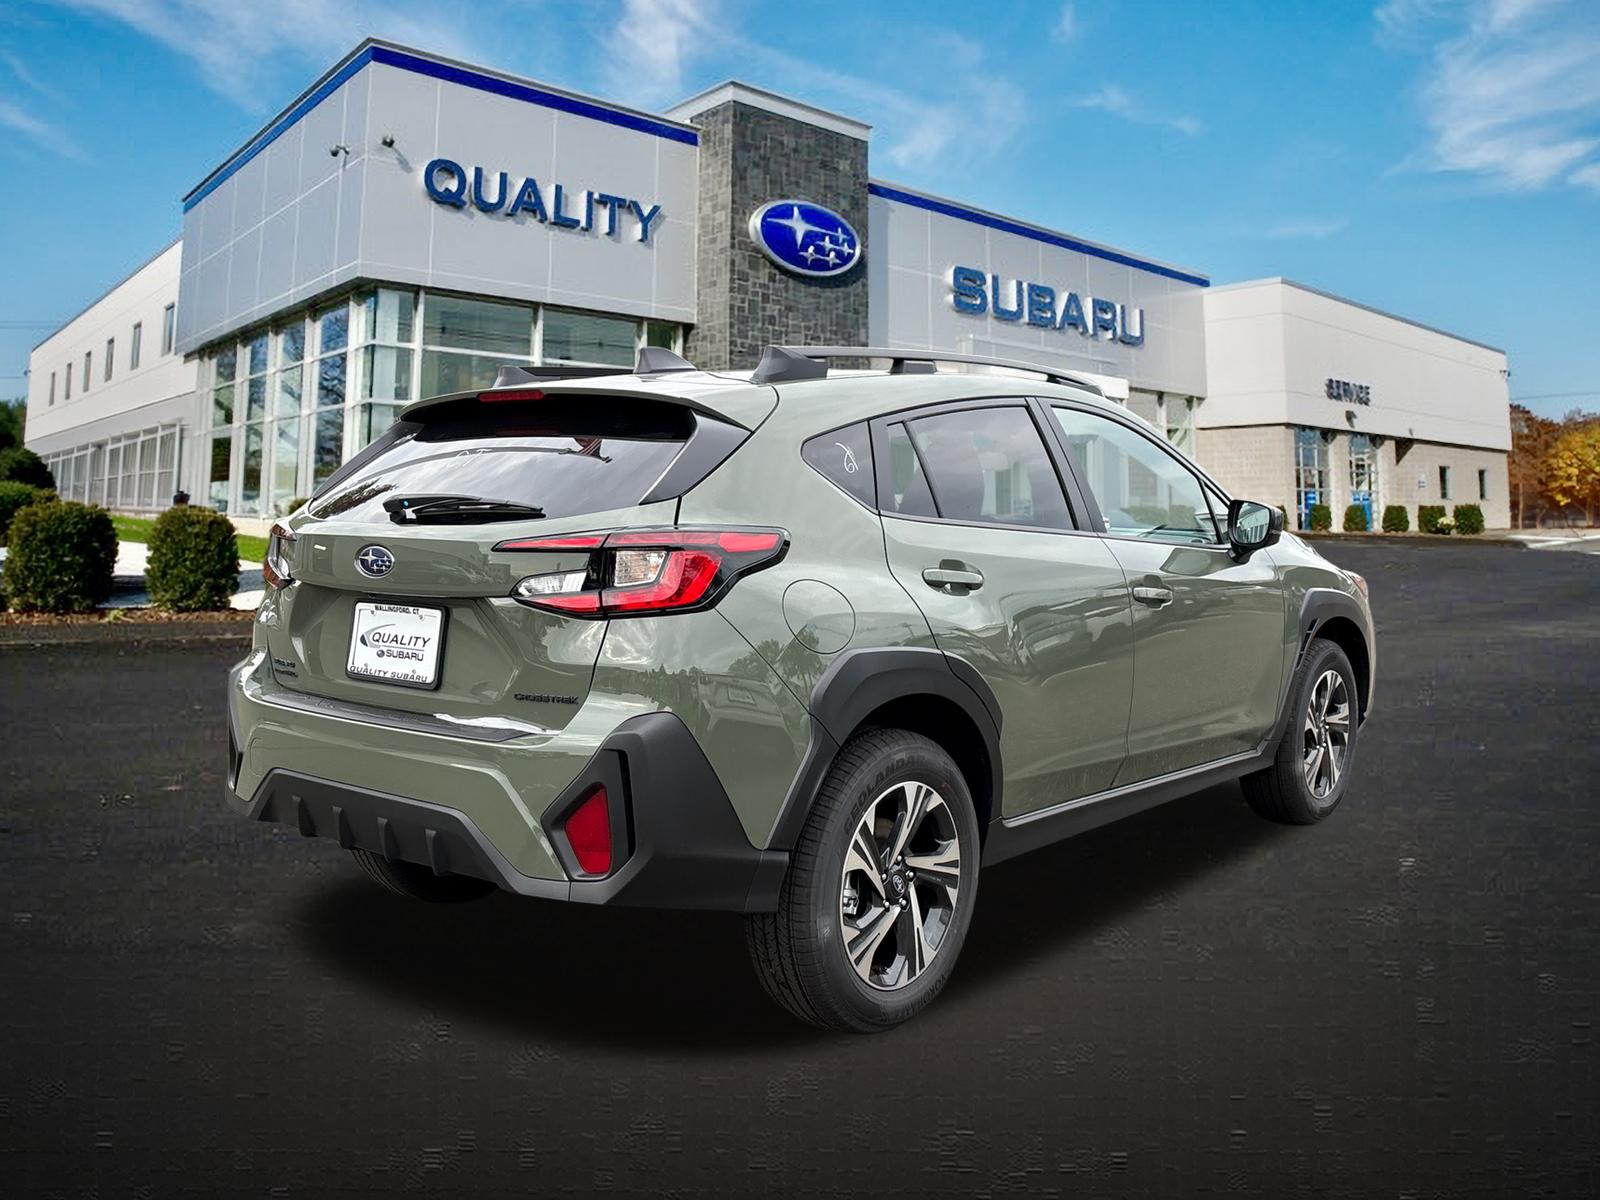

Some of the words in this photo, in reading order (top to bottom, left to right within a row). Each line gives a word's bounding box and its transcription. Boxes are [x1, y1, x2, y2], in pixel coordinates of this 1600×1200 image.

[423, 158, 661, 243] QUALITY
[951, 265, 1145, 346] SUBARU
[1326, 378, 1370, 406] SERVICE
[371, 632, 431, 648] QUALITY
[386, 649, 424, 662] SUBARU
[349, 665, 389, 677] QUALITY
[390, 671, 428, 682] SUBARU
[513, 693, 579, 705] CROSSTREK
